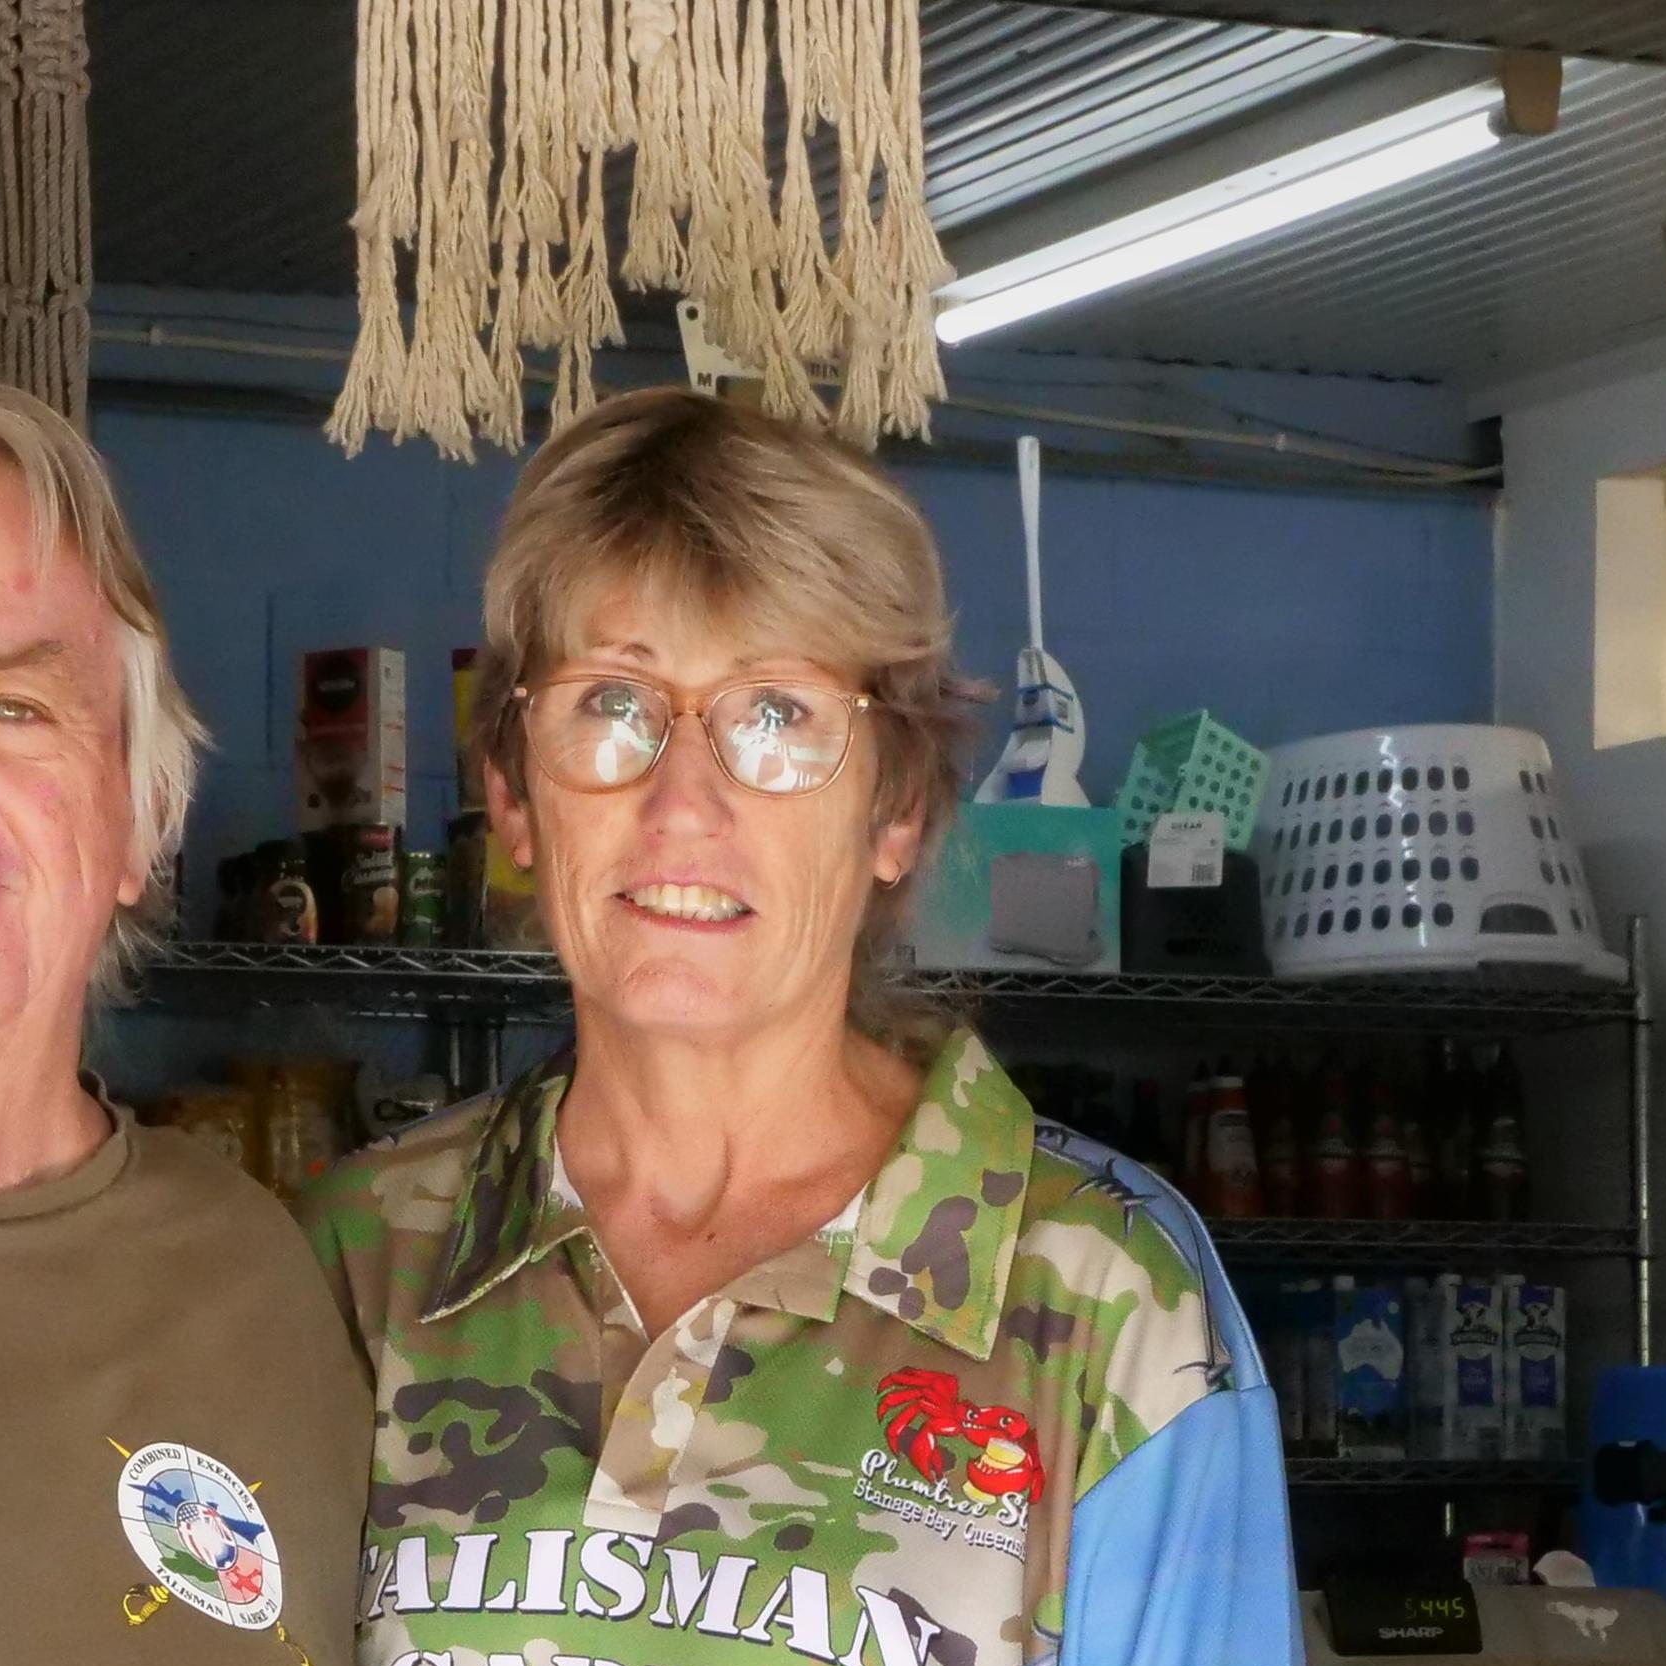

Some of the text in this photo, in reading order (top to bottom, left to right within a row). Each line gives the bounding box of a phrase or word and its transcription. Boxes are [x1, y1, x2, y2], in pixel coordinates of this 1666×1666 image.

[128, 1447, 256, 1514] COMBINED EXERCISE
[852, 1476, 924, 1523] Stanage
[924, 1504, 958, 1541] Bay
[860, 1448, 989, 1518] Plumtree
[155, 1564, 225, 1617] TALISMAN
[1377, 1626, 1445, 1640] SHARP
